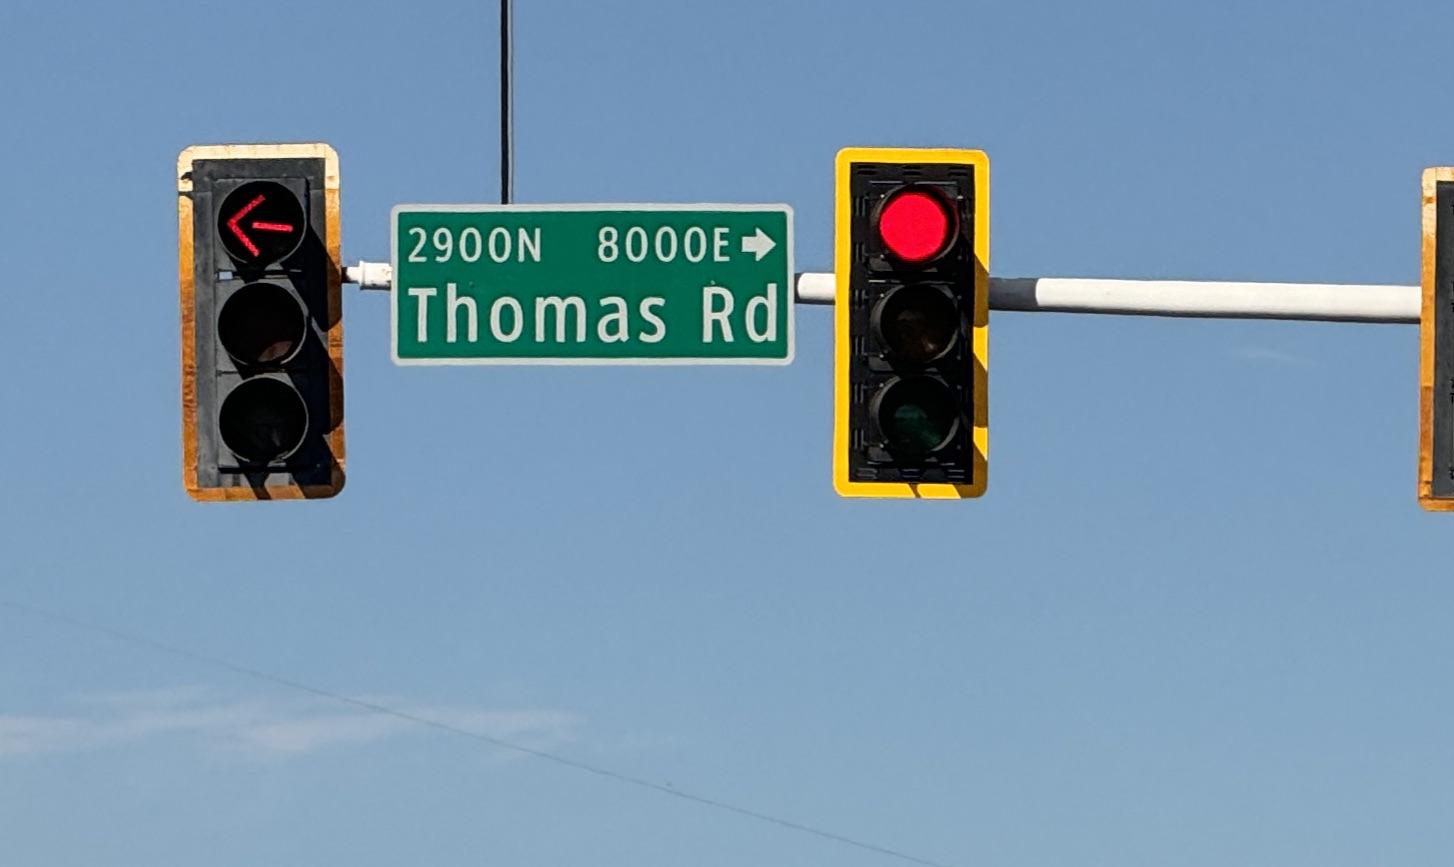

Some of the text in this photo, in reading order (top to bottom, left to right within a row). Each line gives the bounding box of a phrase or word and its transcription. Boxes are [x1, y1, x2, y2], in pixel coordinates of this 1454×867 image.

[408, 226, 730, 263] 2900N 8000E
[408, 283, 777, 343] Thomas Rd
